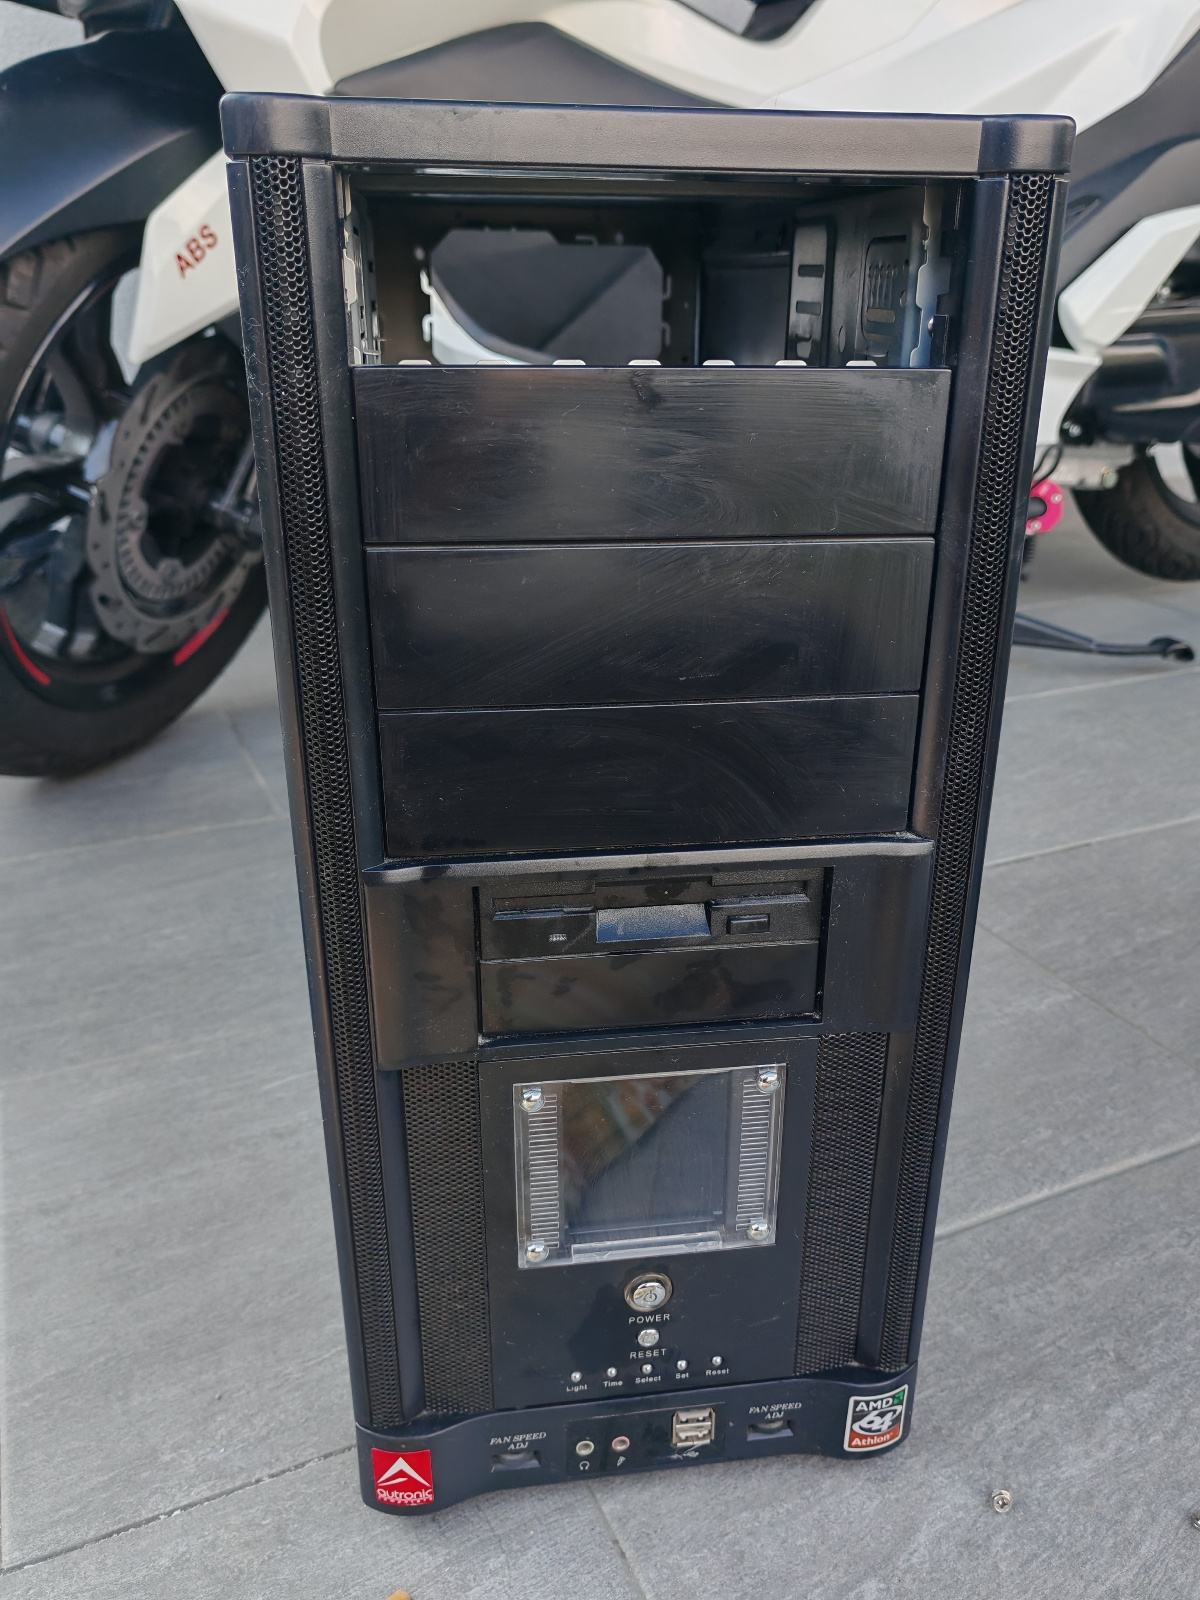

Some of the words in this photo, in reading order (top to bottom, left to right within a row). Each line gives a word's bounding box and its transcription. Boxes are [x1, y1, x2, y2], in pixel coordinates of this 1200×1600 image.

[175, 225, 218, 279] ABS
[628, 1314, 670, 1325] POWER
[630, 1349, 667, 1360] RESET
[566, 1384, 588, 1392] Light
[635, 1376, 661, 1384] Select
[705, 1368, 730, 1376] Reset
[748, 1406, 769, 1414] FAN
[769, 1402, 802, 1411] SPEED
[855, 1397, 893, 1412] AMD
[764, 1411, 784, 1420] ADJ
[489, 1436, 511, 1446] FAN
[512, 1431, 547, 1442] SPEED
[507, 1442, 529, 1450] ADJ
